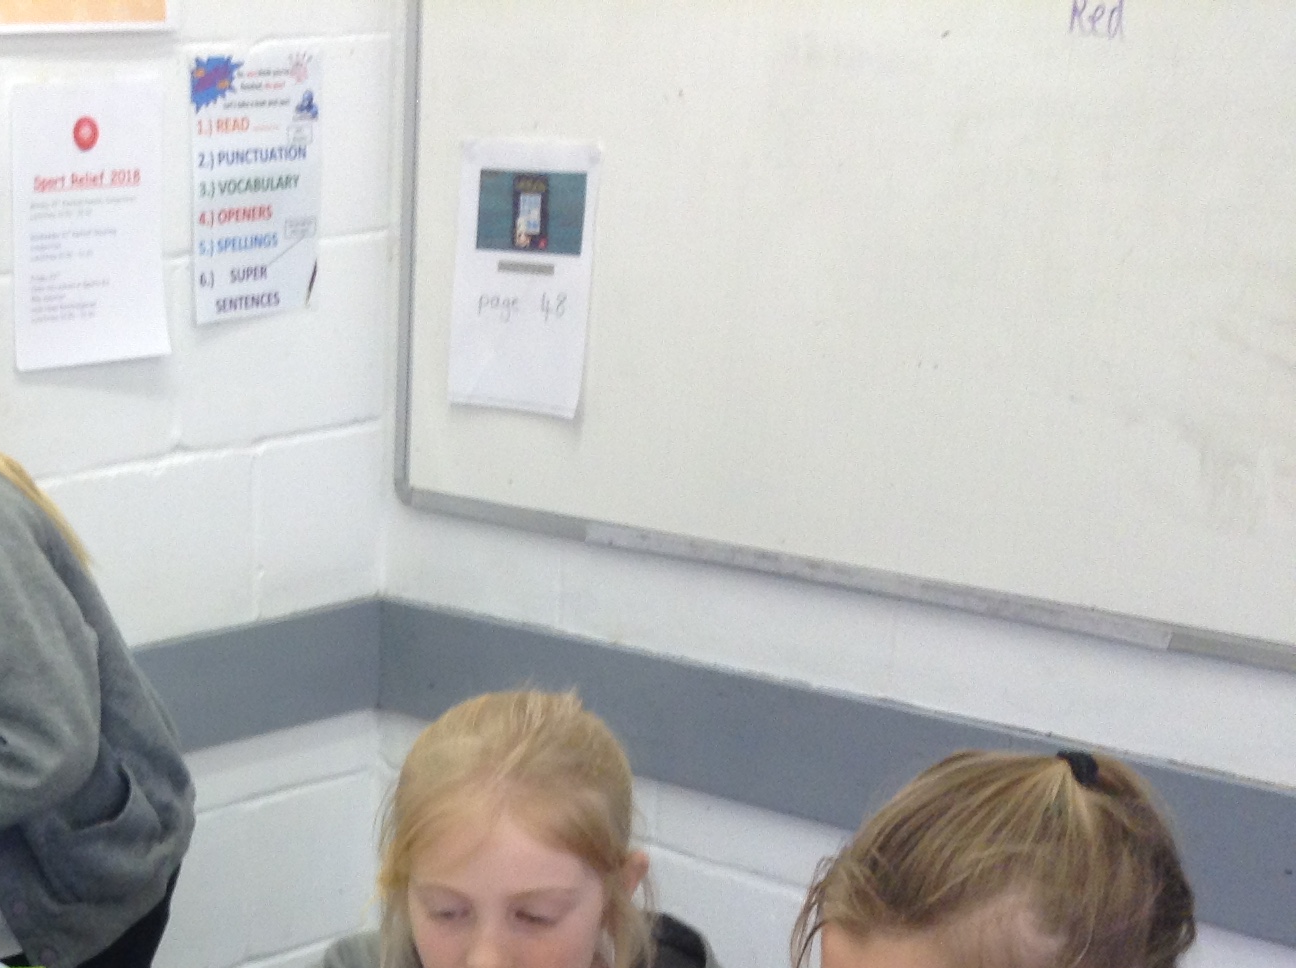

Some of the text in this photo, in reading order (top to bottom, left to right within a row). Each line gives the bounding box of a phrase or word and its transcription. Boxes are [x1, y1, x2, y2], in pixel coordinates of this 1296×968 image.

[216, 116, 250, 133] READ
[217, 145, 307, 168] PUNCTUATION
[217, 173, 300, 196] VOCABULARY
[217, 204, 274, 225] OPENERS
[217, 232, 279, 254] SPELLINGS
[230, 264, 267, 284] SUPER
[215, 291, 280, 315] SENTENCES
[477, 291, 567, 323] page 48
